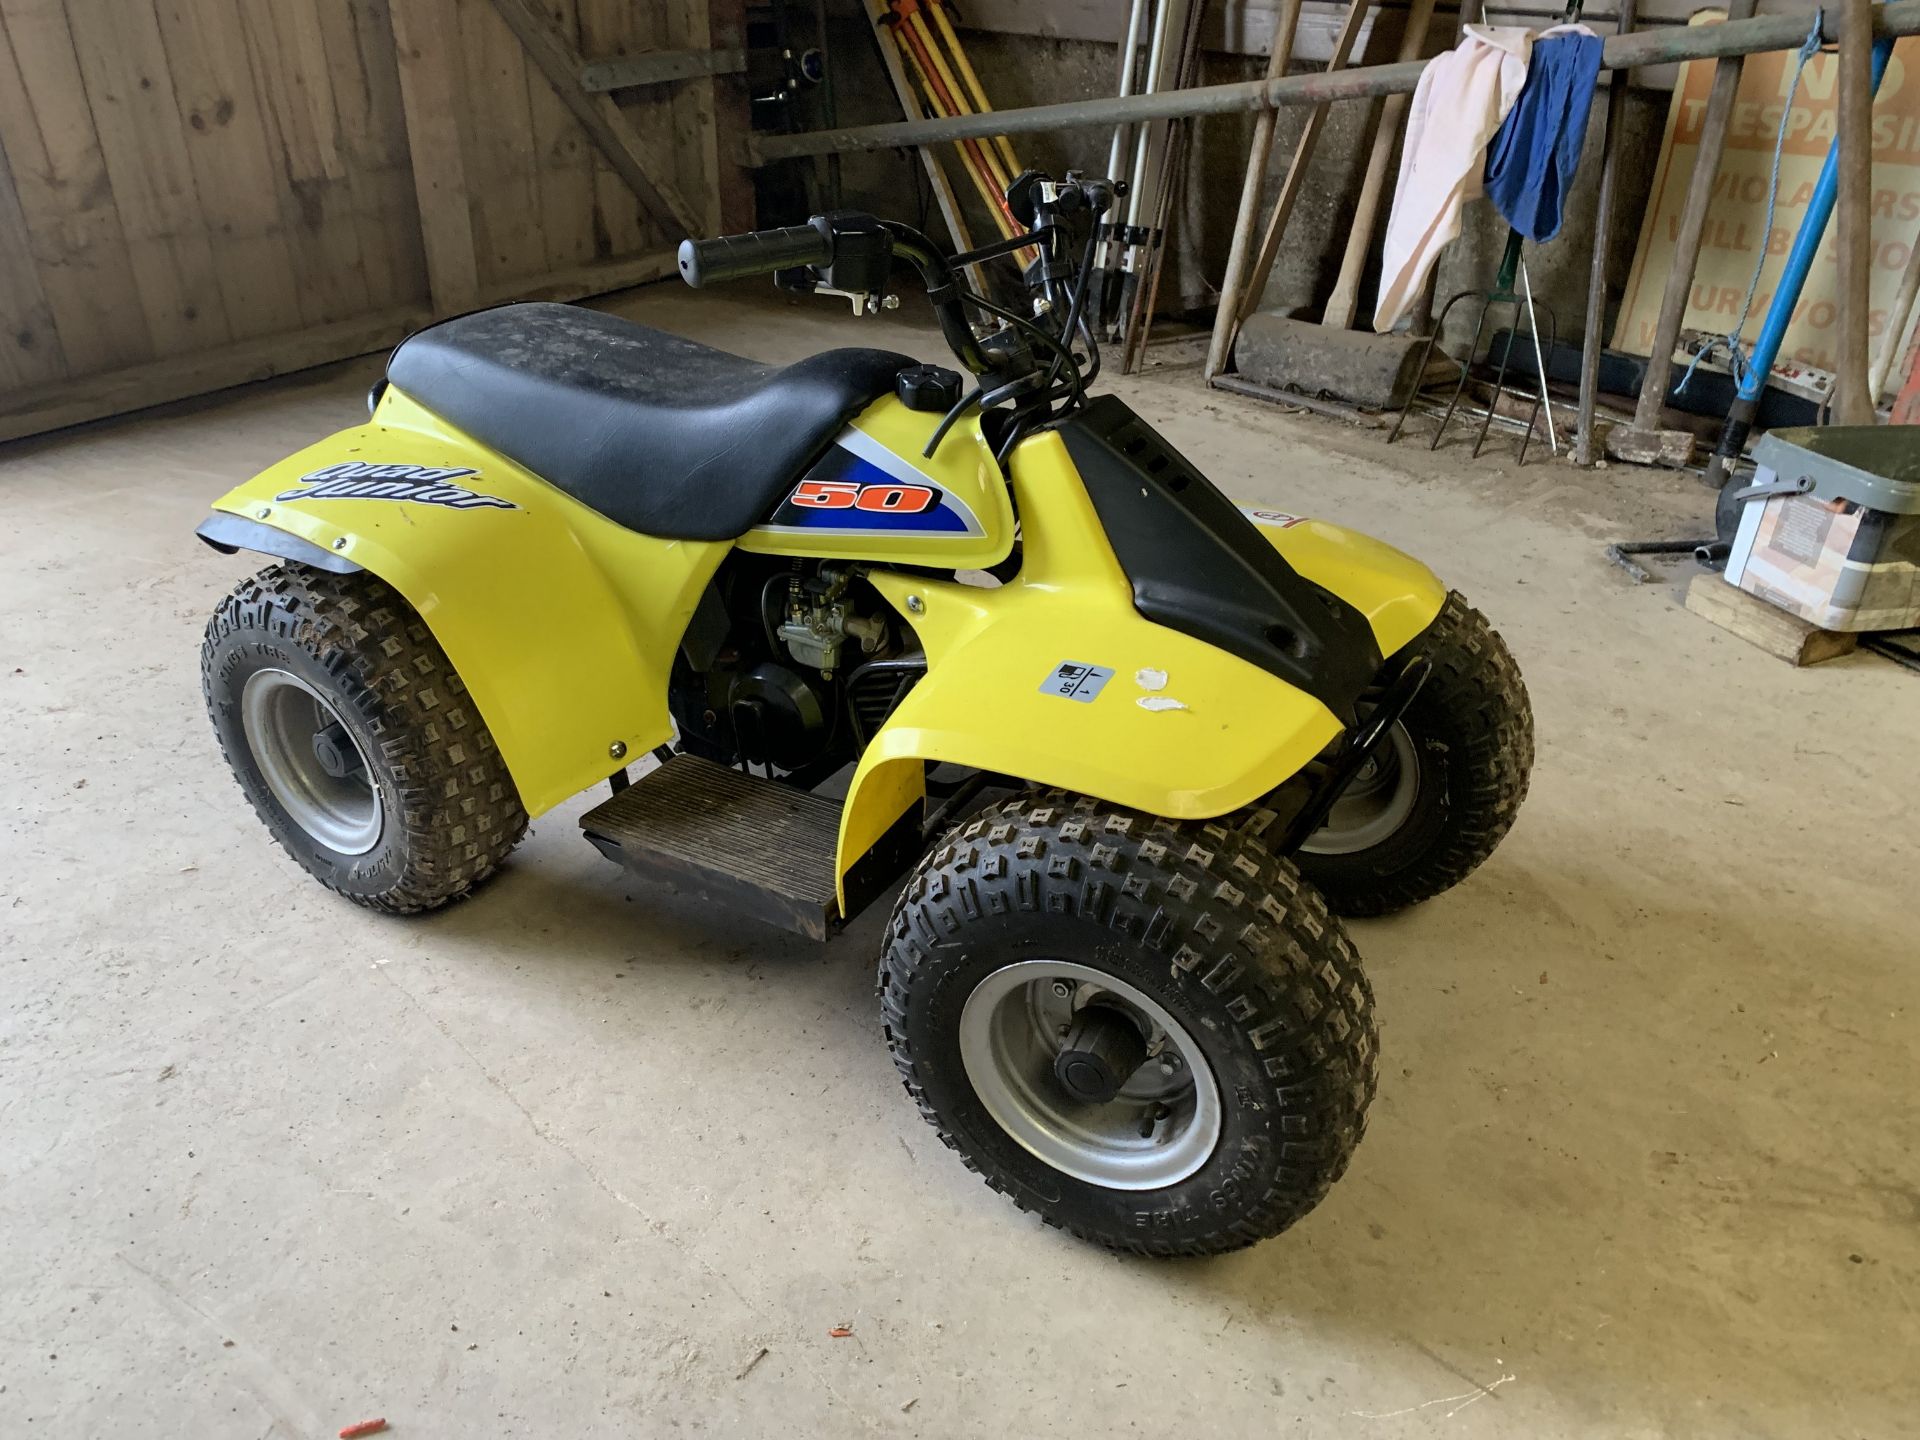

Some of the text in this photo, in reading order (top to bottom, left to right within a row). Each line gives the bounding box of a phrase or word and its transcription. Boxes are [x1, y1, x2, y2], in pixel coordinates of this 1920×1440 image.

[1684, 98, 1920, 153] TESPASI
[1711, 172, 1920, 222] VIOLARS
[1690, 284, 1888, 337] URVOS
[300, 461, 478, 484] Quad
[275, 477, 518, 510] Junior
[791, 480, 936, 513] 50
[1059, 681, 1075, 694] 30
